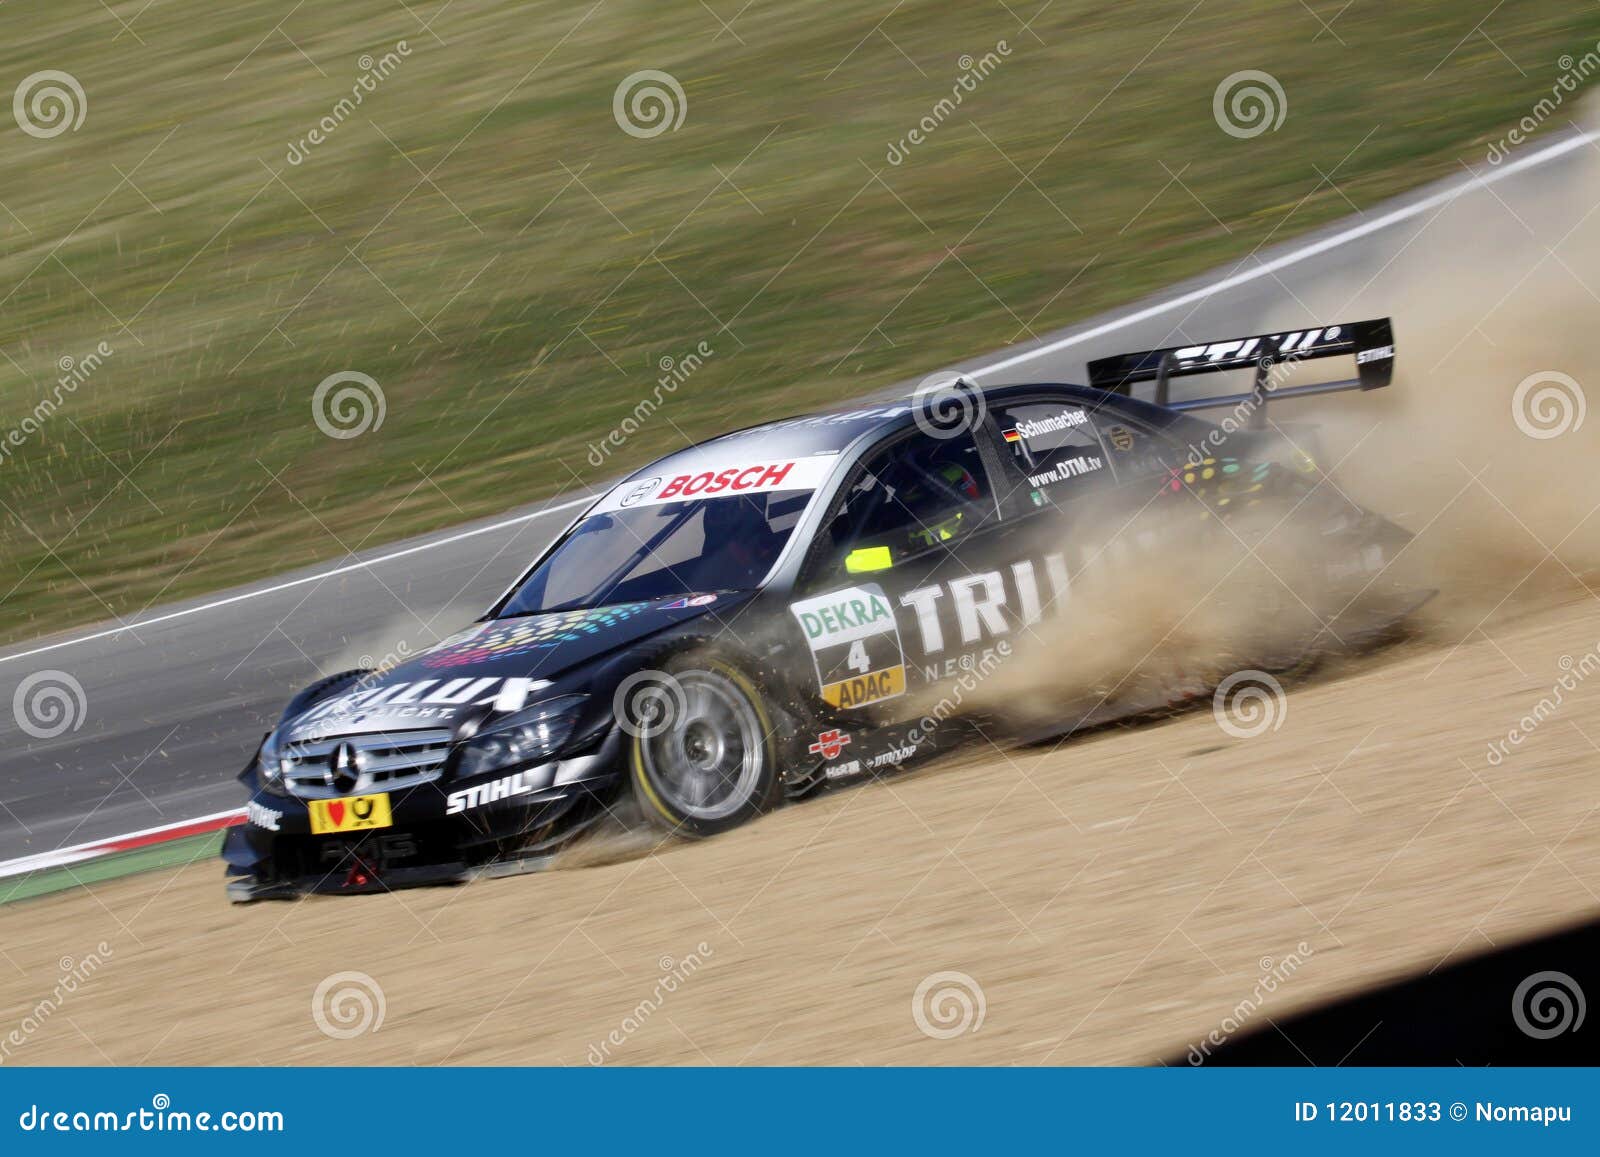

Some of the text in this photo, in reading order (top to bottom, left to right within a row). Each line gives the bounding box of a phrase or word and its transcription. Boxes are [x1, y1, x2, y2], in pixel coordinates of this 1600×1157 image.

[1016, 410, 1088, 439] Schumacher
[657, 462, 796, 499] BOSCH
[1028, 456, 1102, 487] www.DTM.tv
[799, 595, 890, 639] DEKRA
[848, 639, 872, 674] 4
[838, 671, 892, 708] ADAC
[446, 773, 532, 815] STIHL
